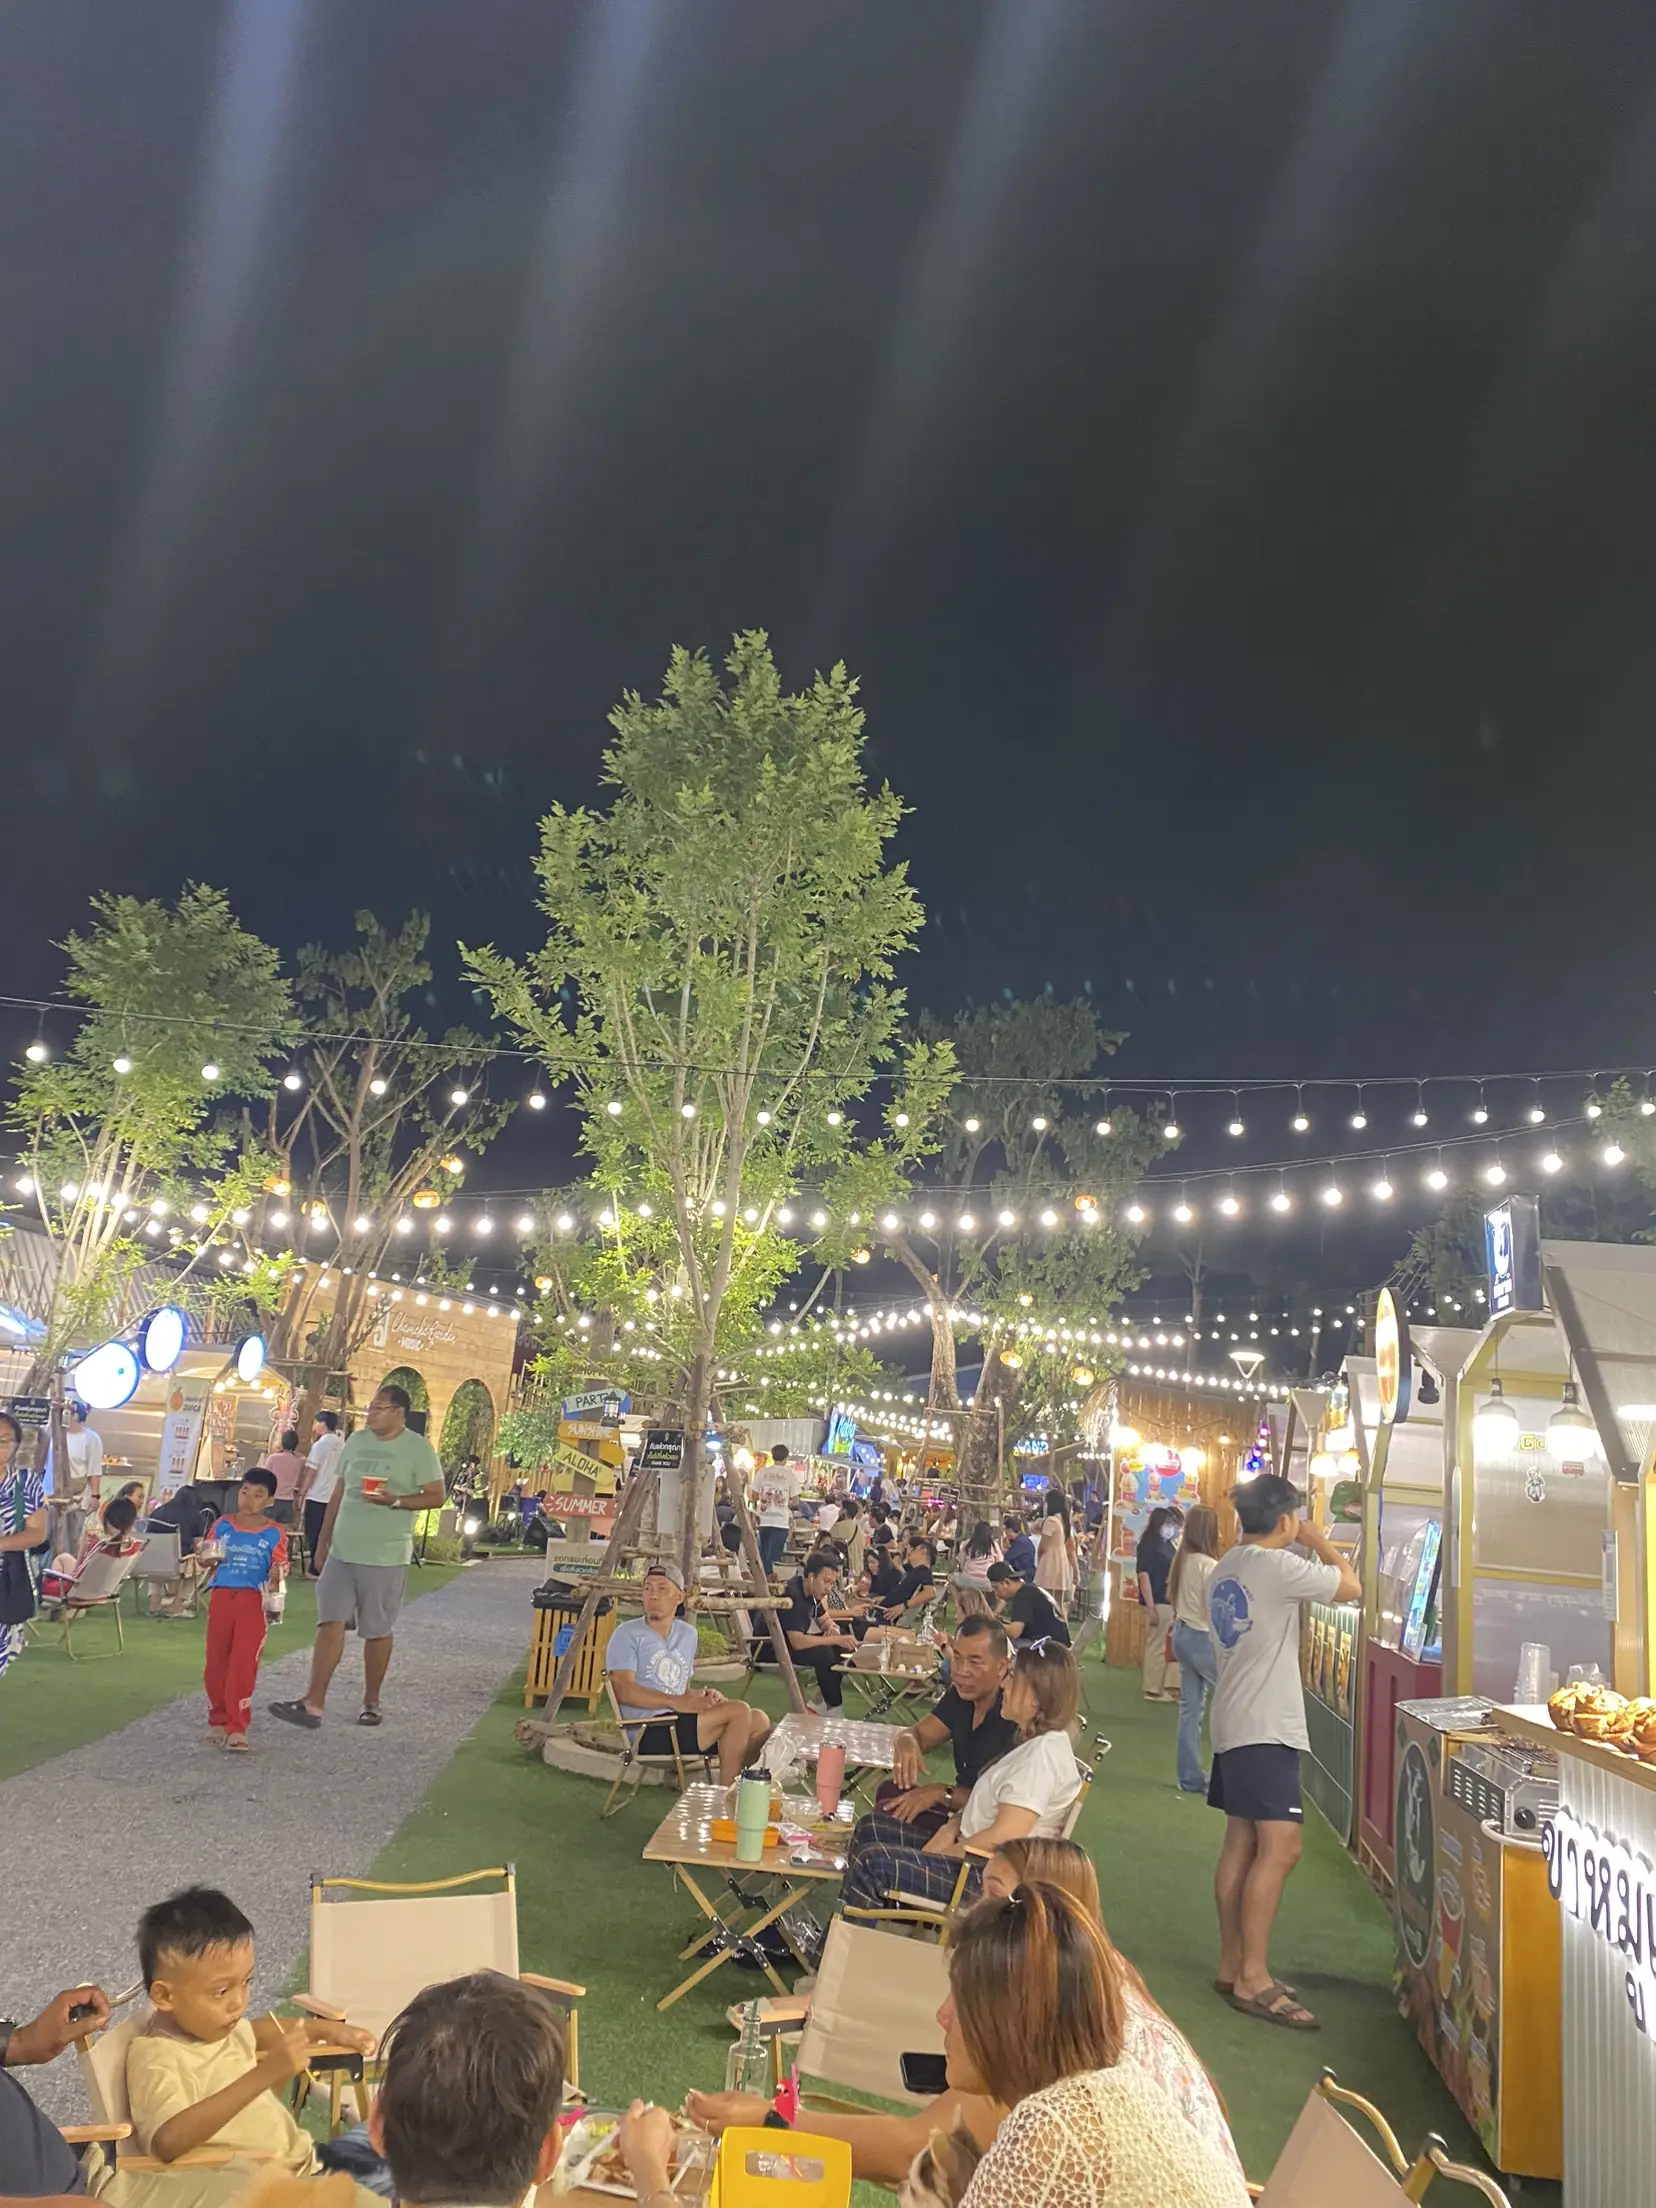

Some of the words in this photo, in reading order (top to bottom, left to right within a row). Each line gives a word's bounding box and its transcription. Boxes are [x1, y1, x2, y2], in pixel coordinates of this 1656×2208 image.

[576, 1391, 609, 1409] PART
[562, 1451, 600, 1478] ALOHA
[555, 1496, 608, 1516] SUMMER
